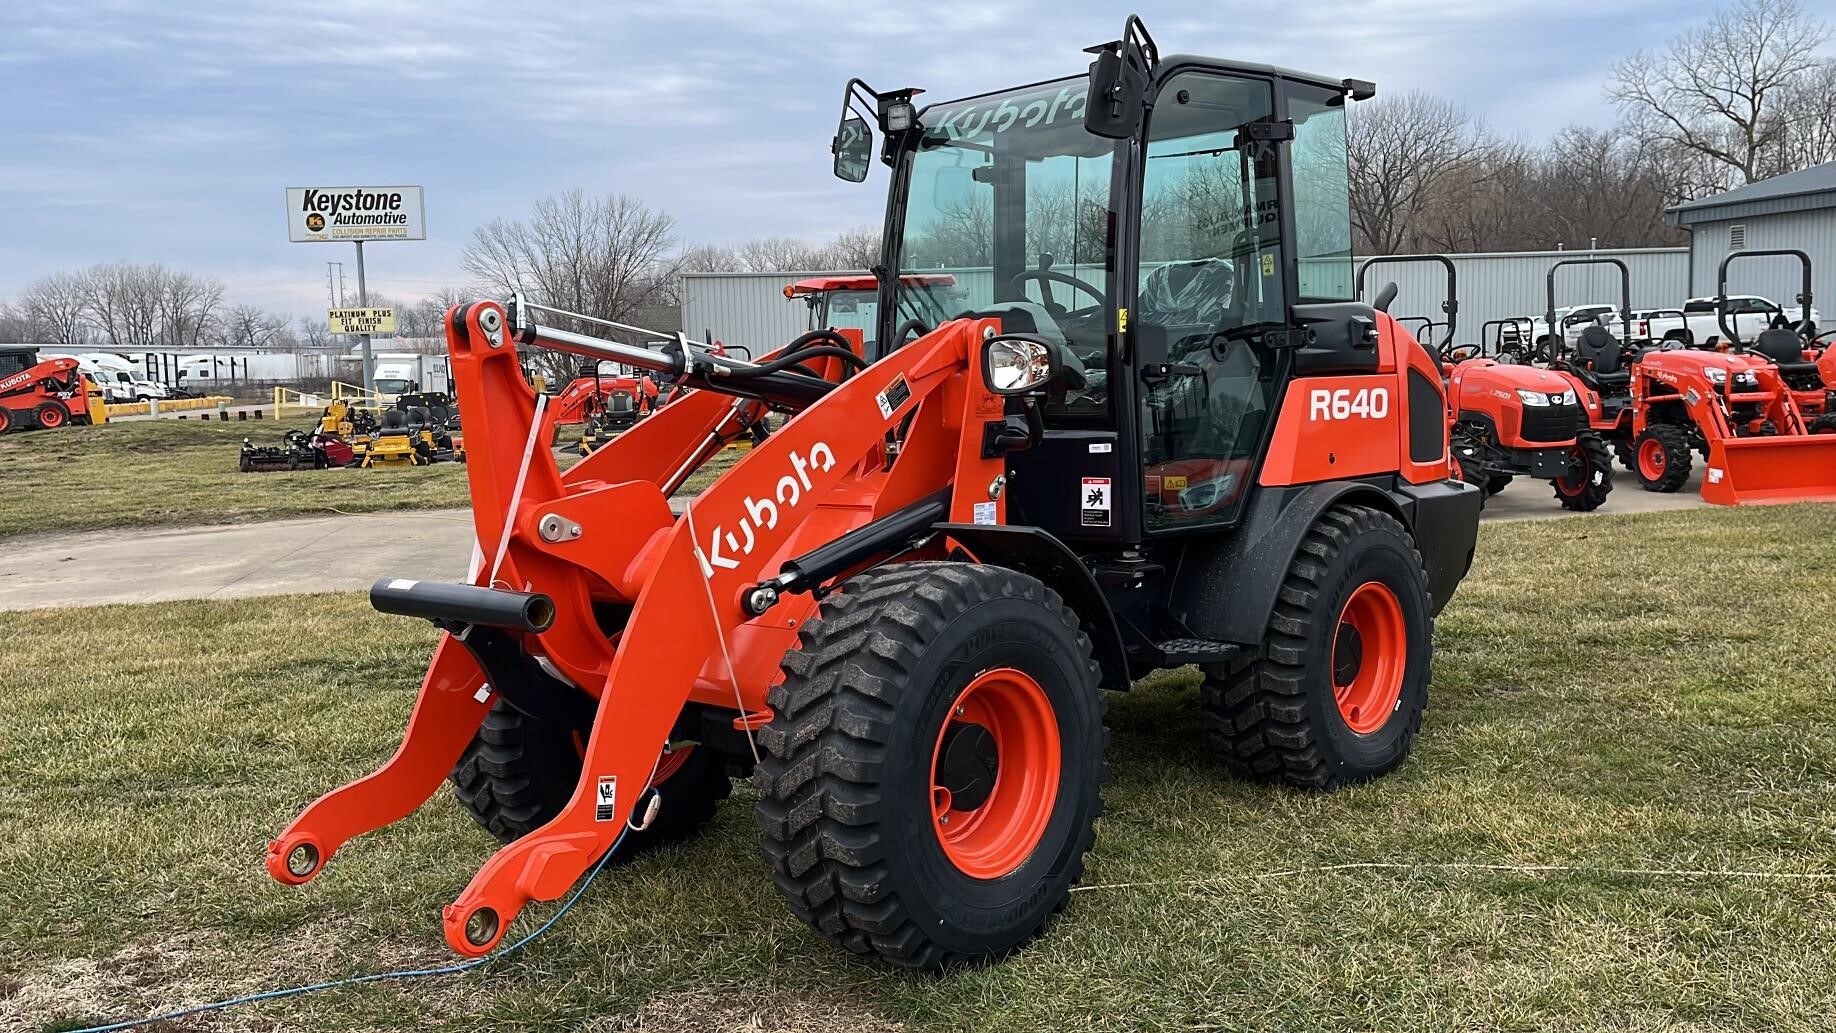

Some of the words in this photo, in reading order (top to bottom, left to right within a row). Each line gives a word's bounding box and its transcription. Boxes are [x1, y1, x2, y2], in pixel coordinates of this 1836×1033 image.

[933, 87, 1088, 141] Kubota
[302, 189, 402, 216] Keystone
[333, 211, 407, 225] Automotive
[0, 373, 31, 390] KUBOTA
[1310, 387, 1388, 421] R640
[693, 441, 837, 580] Kubota
